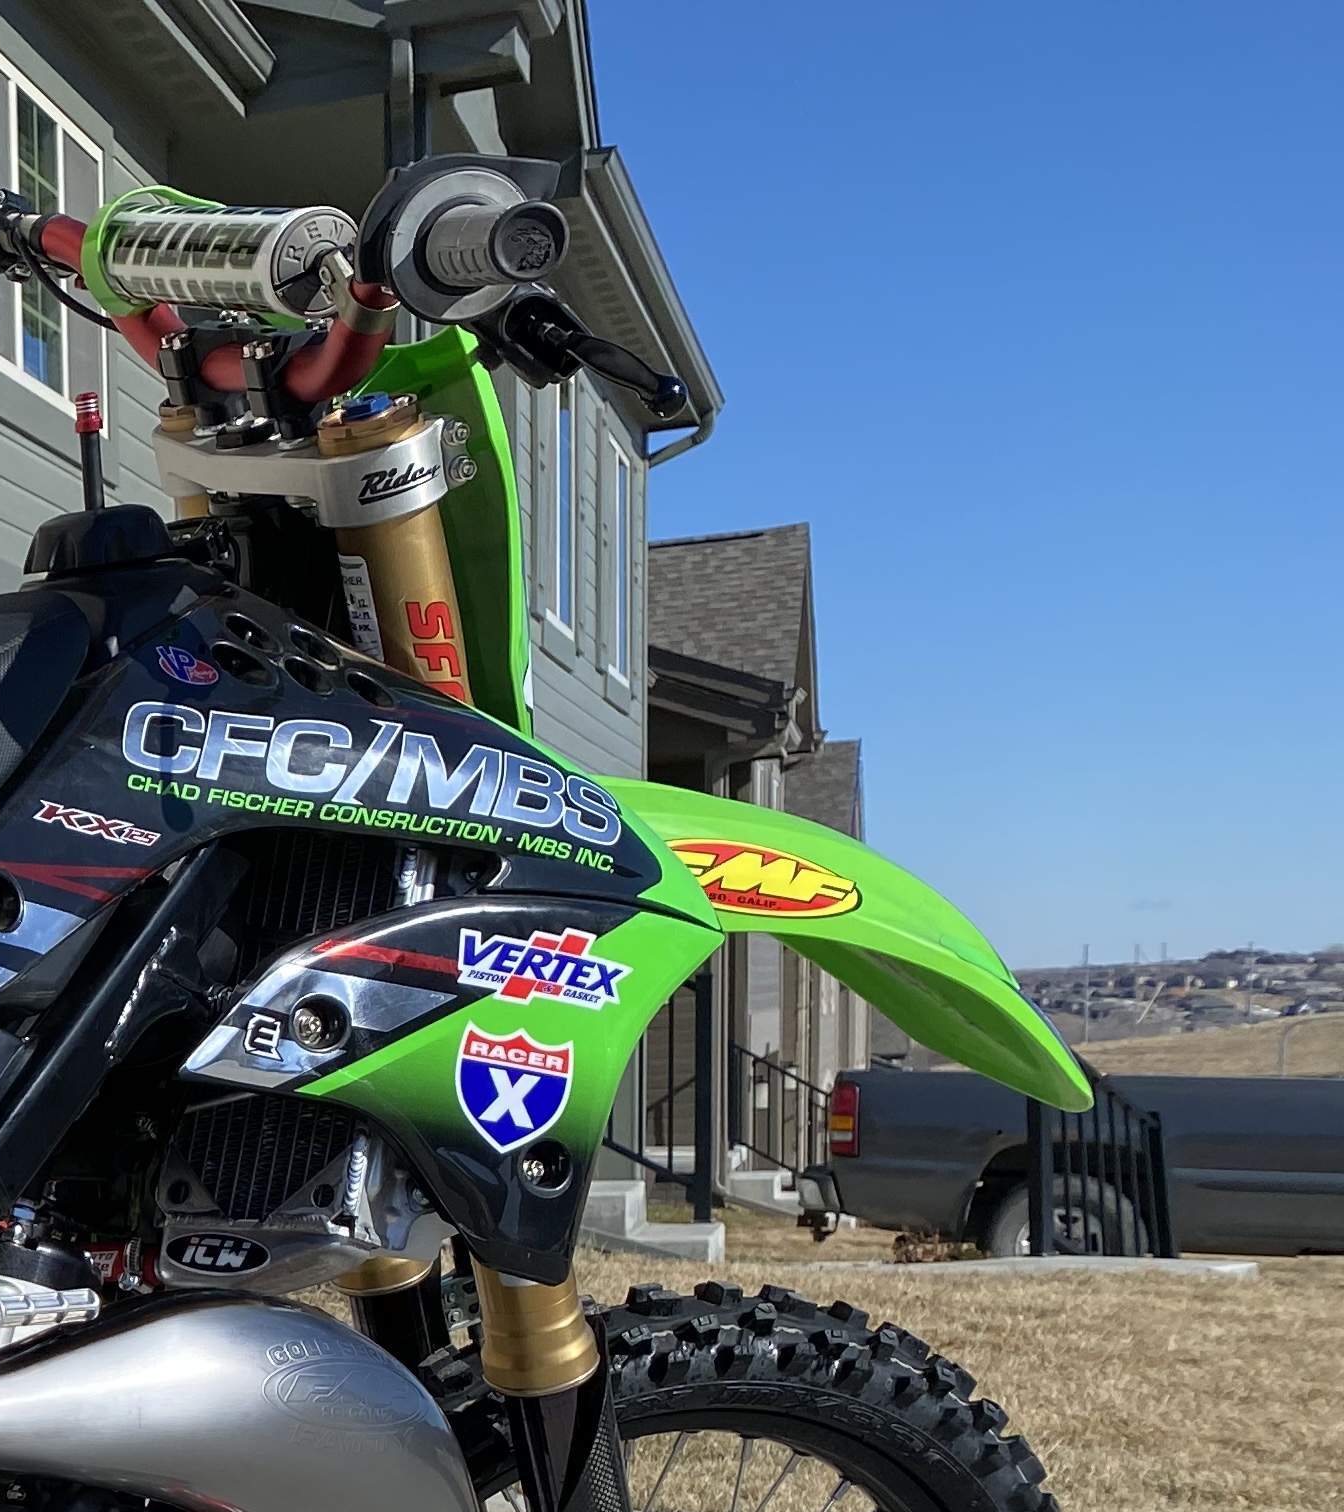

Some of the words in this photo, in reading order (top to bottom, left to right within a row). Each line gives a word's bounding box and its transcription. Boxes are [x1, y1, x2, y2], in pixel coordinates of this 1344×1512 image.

[156, 646, 197, 681] VP
[123, 701, 621, 846] CFC/MBS
[127, 774, 201, 801] CHAD
[207, 788, 314, 819] FISCHER
[517, 832, 572, 860] MBS
[575, 847, 616, 874] INC.
[462, 934, 624, 998] VERTEX
[467, 969, 507, 984] PISTON
[543, 983, 554, 995] &
[563, 989, 602, 1004] GASKET
[469, 1040, 566, 1072] RACER
[478, 1067, 541, 1130] X
